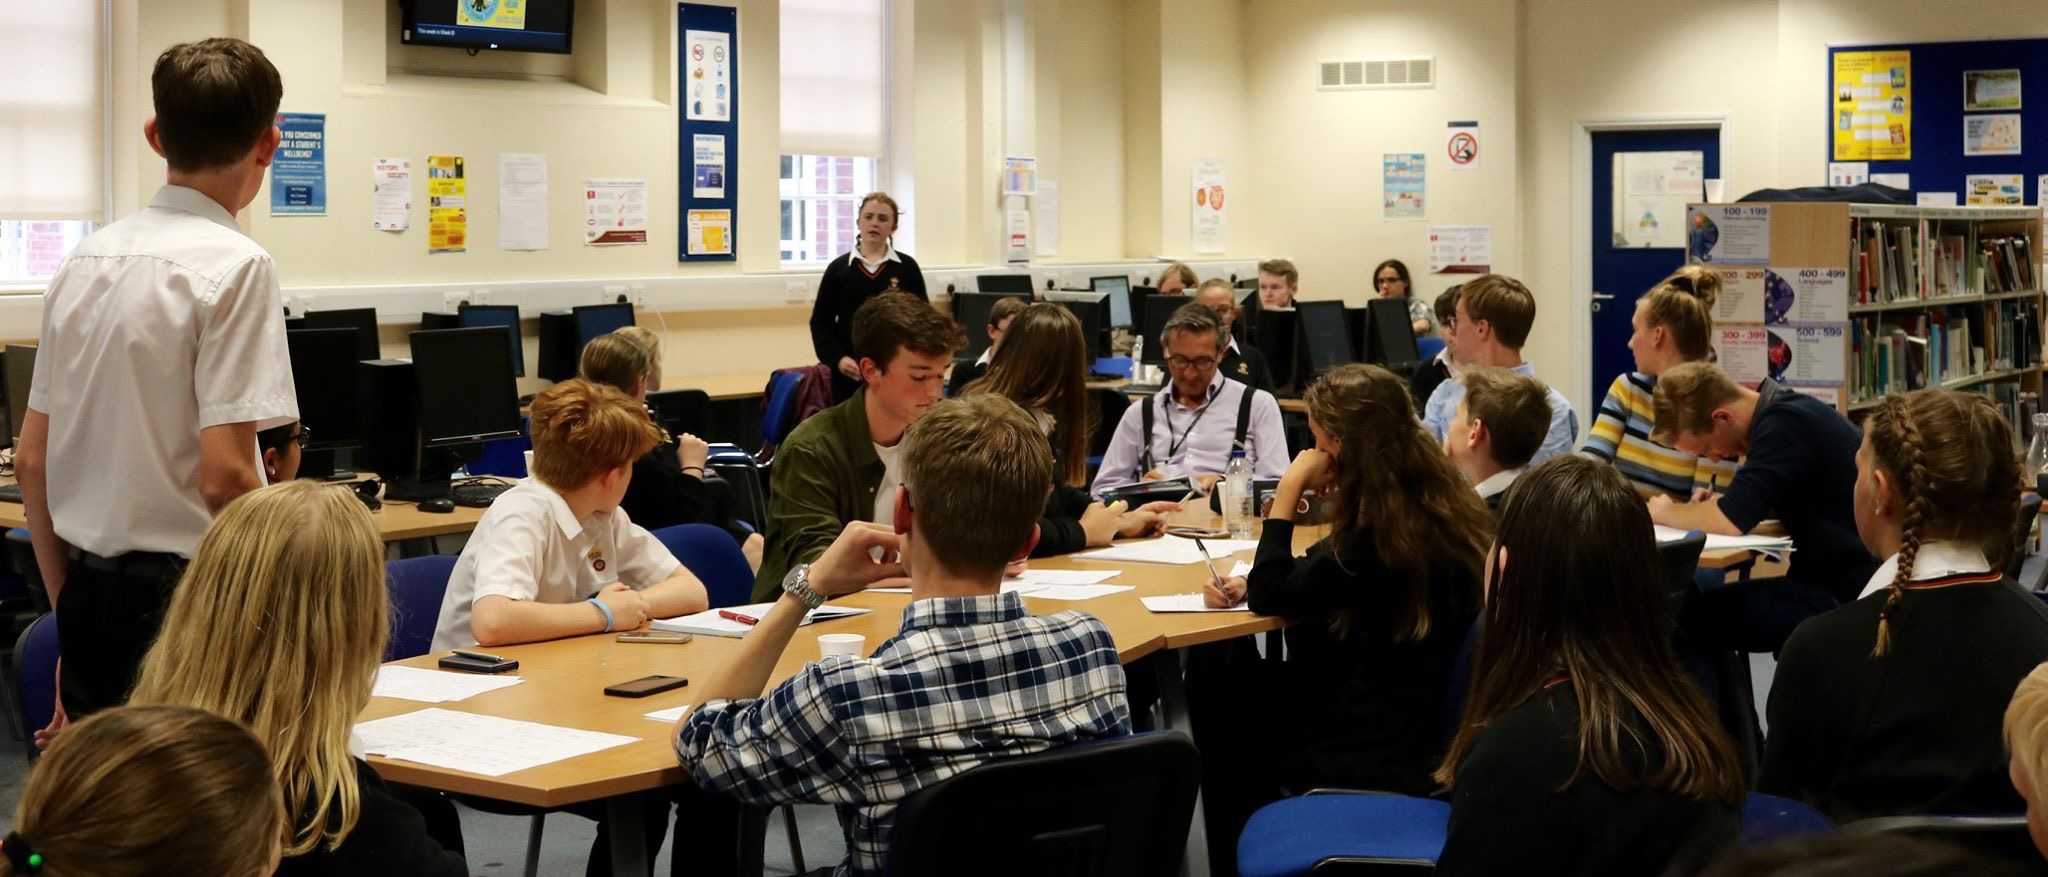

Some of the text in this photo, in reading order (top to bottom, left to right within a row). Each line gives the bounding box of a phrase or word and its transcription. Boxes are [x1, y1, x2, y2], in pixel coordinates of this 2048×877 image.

[1724, 207, 1741, 215] 100
[1750, 207, 1767, 215] 199
[1745, 271, 1764, 279] 299
[1799, 269, 1818, 278] 400
[1826, 269, 1846, 278] 499
[1798, 278, 1833, 286] Languages
[1721, 331, 1740, 339] 300
[1748, 331, 1766, 339] 399
[1796, 327, 1815, 336] 500
[1823, 327, 1842, 336] 599
